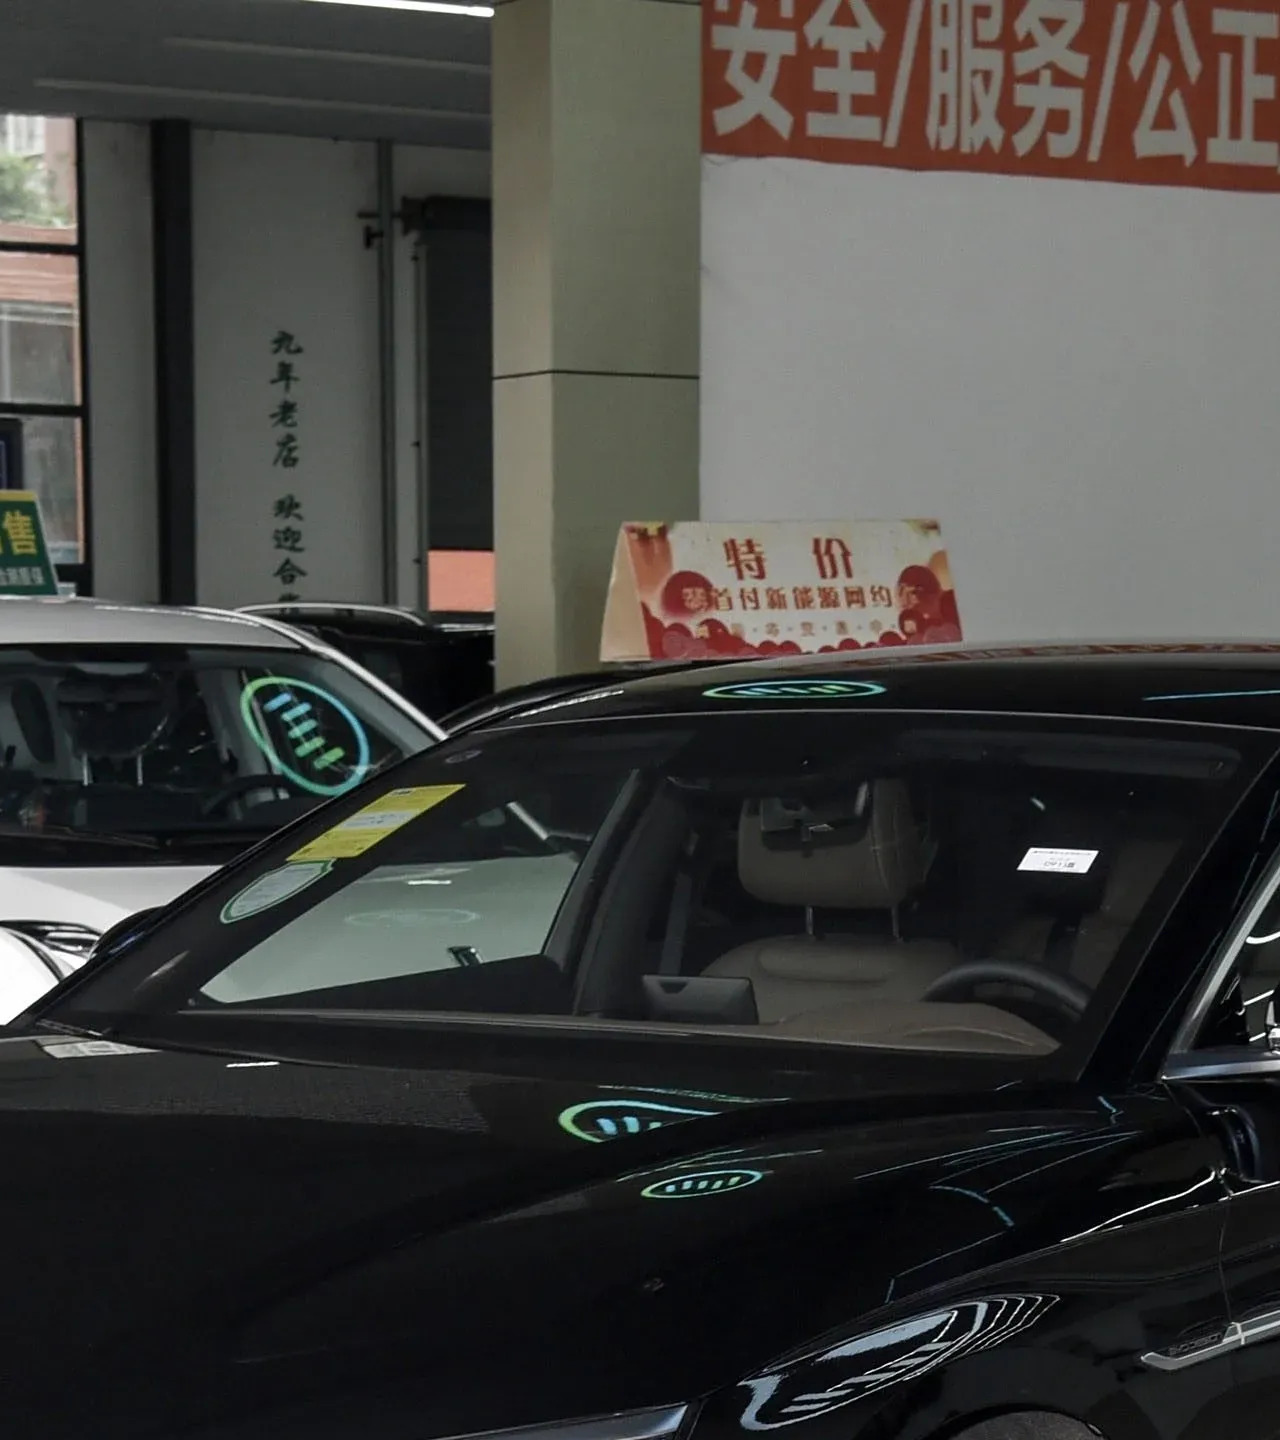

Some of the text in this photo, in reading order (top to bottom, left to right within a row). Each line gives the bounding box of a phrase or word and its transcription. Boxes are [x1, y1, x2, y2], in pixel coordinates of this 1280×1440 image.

[270, 331, 303, 468] 九年老店
[723, 537, 854, 580] 特价
